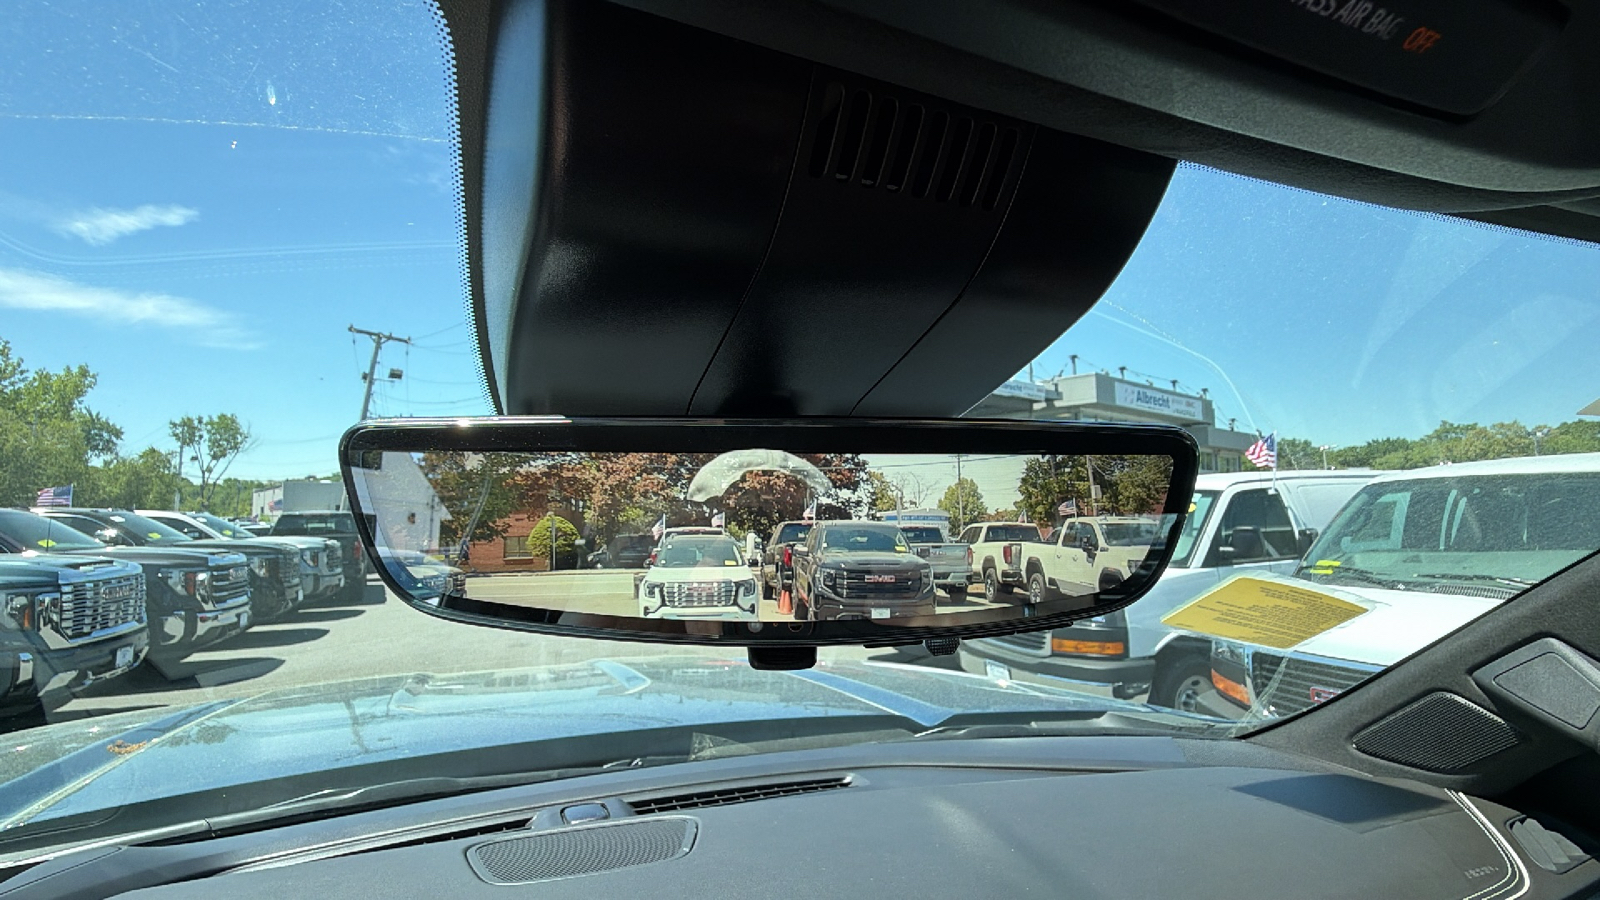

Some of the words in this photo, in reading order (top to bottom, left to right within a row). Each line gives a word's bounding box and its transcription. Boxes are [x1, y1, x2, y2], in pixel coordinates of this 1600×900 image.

[1332, 0, 1373, 28] AIR
[1402, 26, 1442, 54] OFF
[1136, 389, 1171, 409] Albrecht
